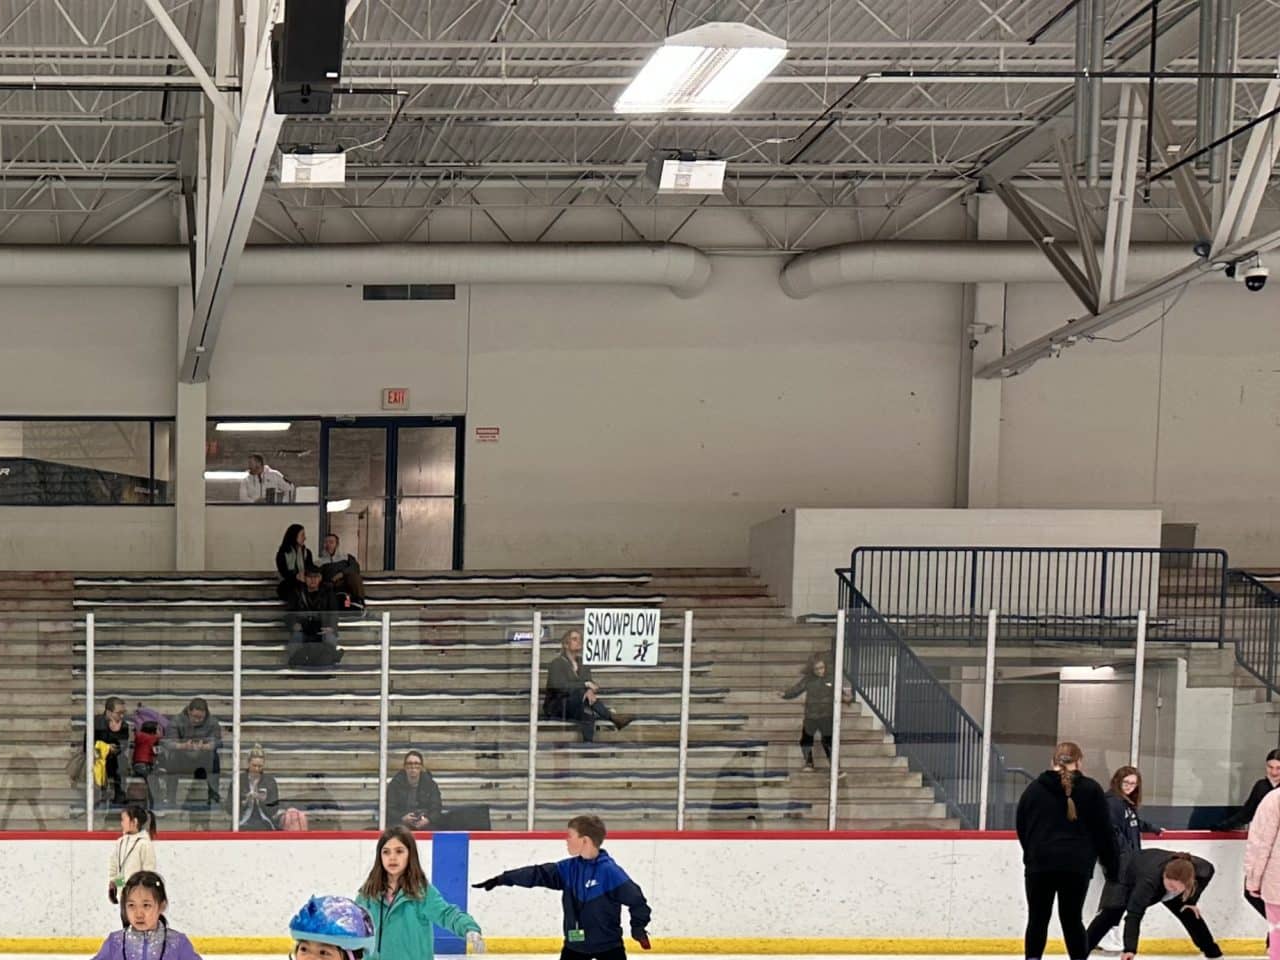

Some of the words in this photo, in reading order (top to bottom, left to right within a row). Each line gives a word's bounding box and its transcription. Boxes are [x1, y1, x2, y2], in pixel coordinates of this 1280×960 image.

[586, 612, 657, 637] SNOWPLOW
[585, 638, 611, 662] SAM
[615, 639, 623, 662] 2
